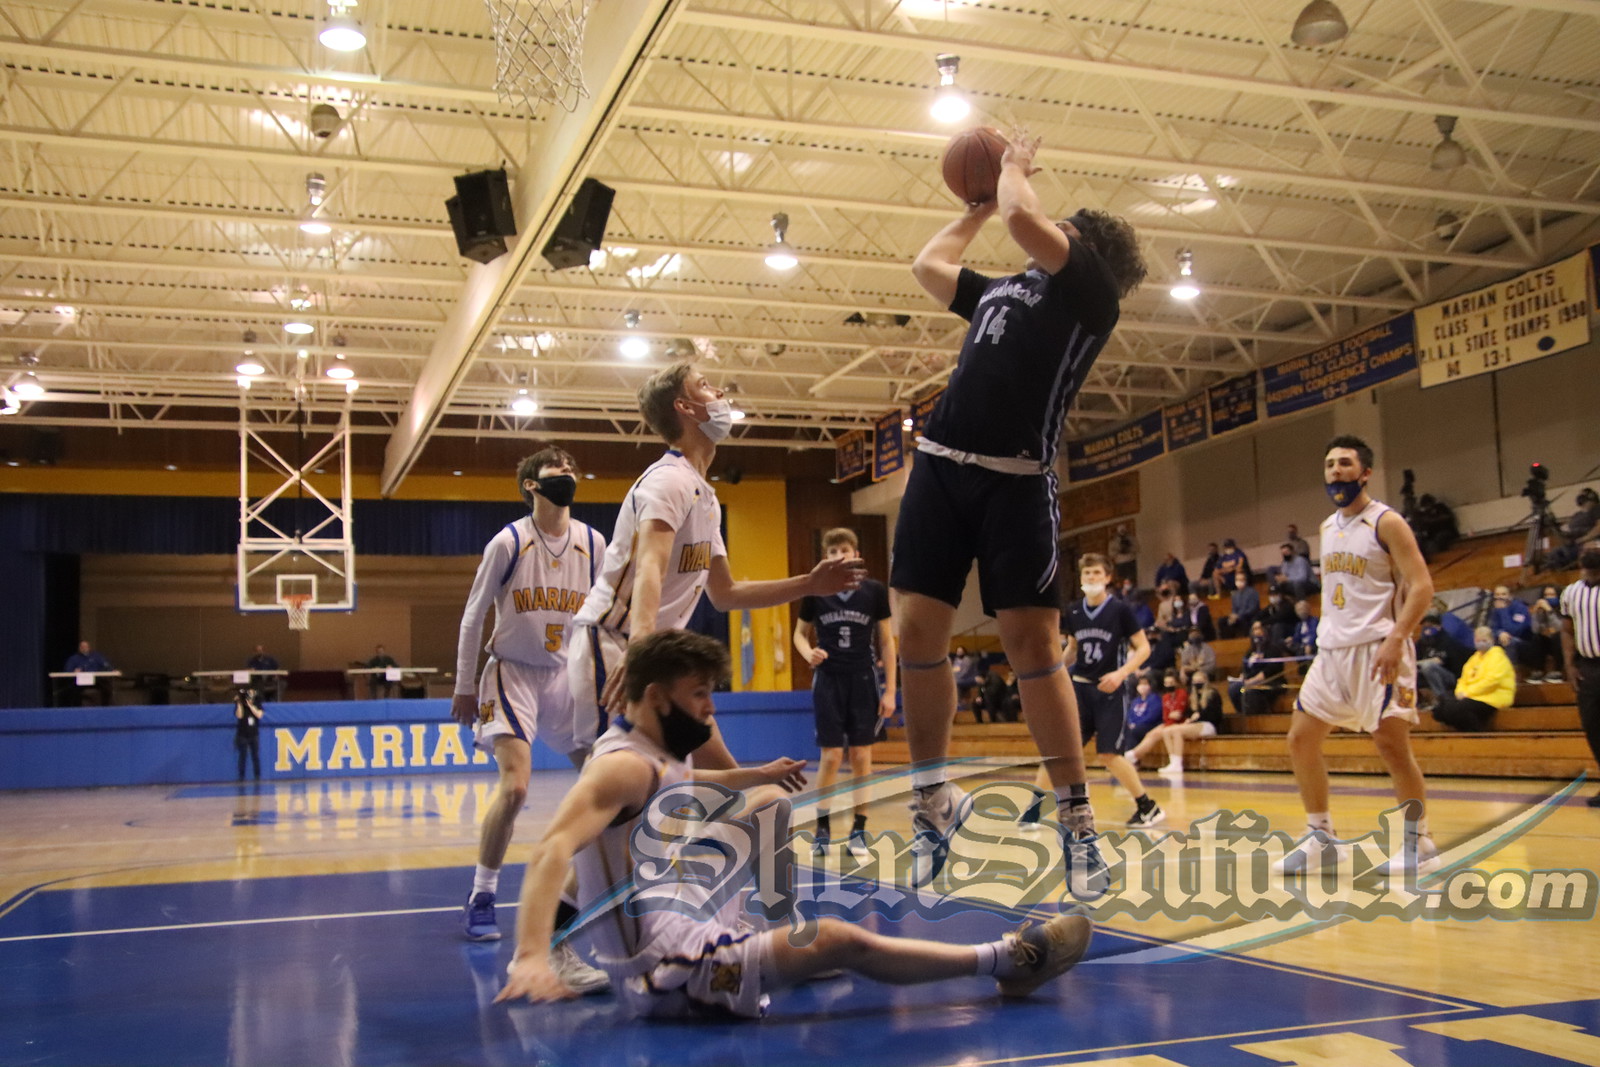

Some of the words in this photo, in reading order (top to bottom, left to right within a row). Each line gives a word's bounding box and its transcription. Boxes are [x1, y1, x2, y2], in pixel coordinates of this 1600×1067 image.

[1442, 289, 1497, 319] MARIAN
[1506, 270, 1555, 301] COLTS
[974, 305, 1011, 345] 14
[1434, 319, 1469, 341] CLASS
[1503, 287, 1566, 322] FOOTBALL
[1466, 330, 1499, 352] STATE
[1505, 314, 1550, 342] CHAMPS
[1312, 344, 1341, 364] COLTS
[1327, 352, 1359, 370] CLASS
[1331, 583, 1346, 610] 4
[544, 623, 565, 652] 5
